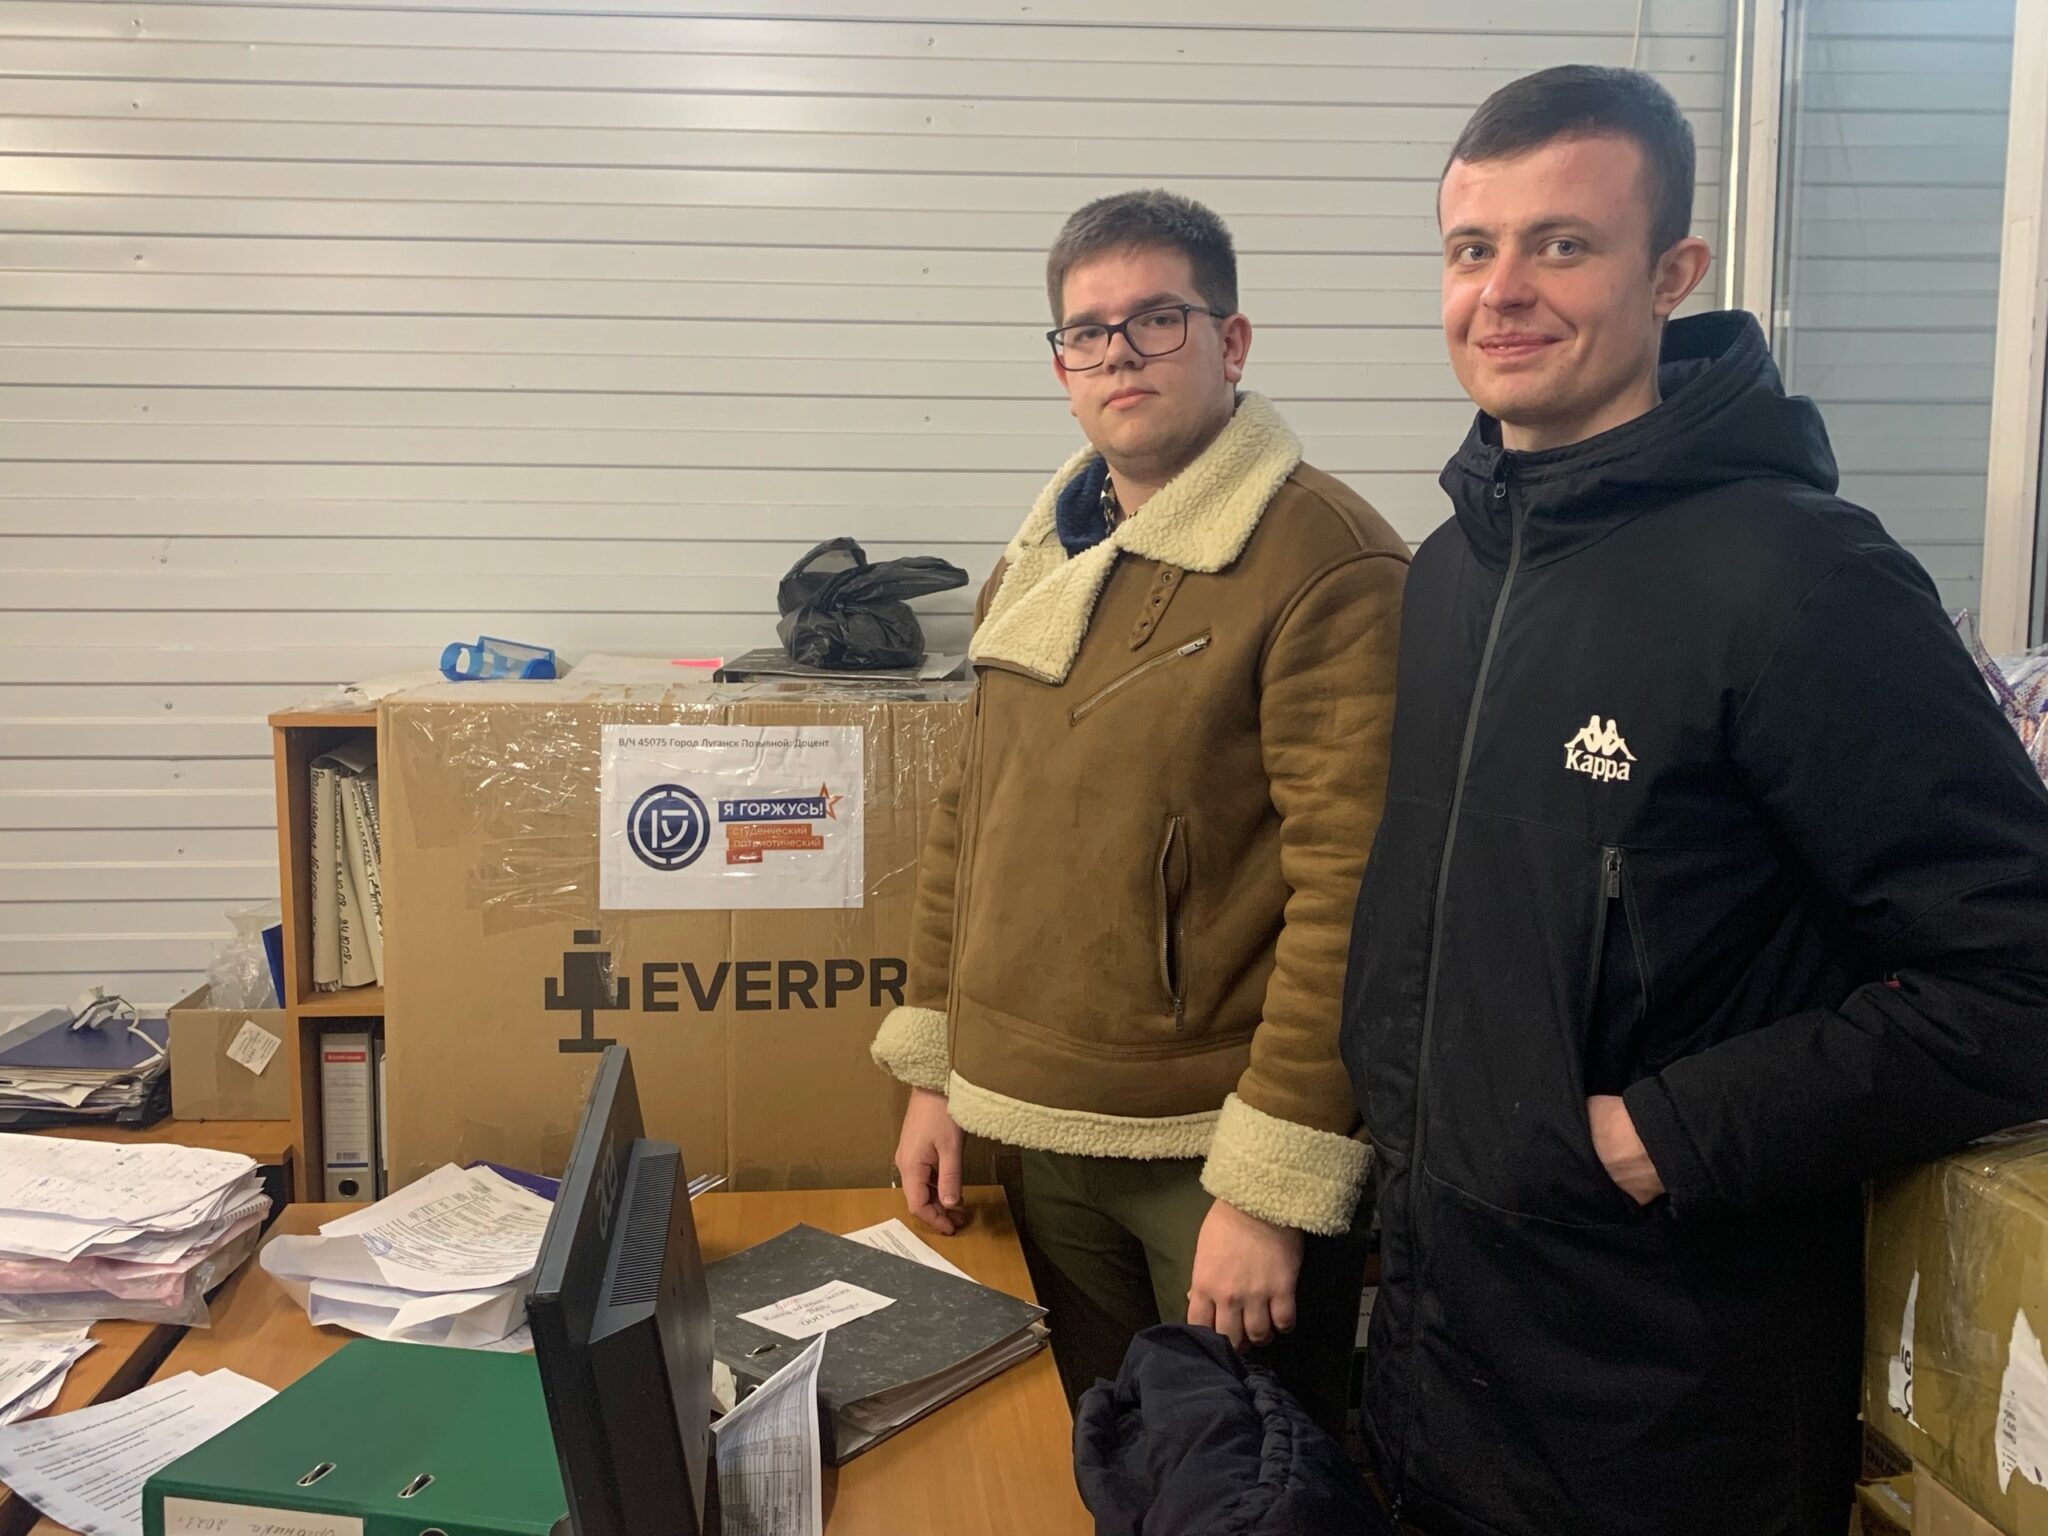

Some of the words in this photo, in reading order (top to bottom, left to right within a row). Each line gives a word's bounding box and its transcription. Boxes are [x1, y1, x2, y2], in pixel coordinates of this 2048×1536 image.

[618, 737, 636, 748] В/Ч
[638, 737, 667, 747] 45075
[669, 738, 699, 748] Город
[701, 738, 739, 748] Луганск
[793, 739, 830, 749] Доцент
[1564, 748, 1631, 783] Kappa
[723, 803, 734, 816] Я
[739, 802, 823, 816] ГОРЖУСЬ!
[733, 824, 807, 837] студенческий
